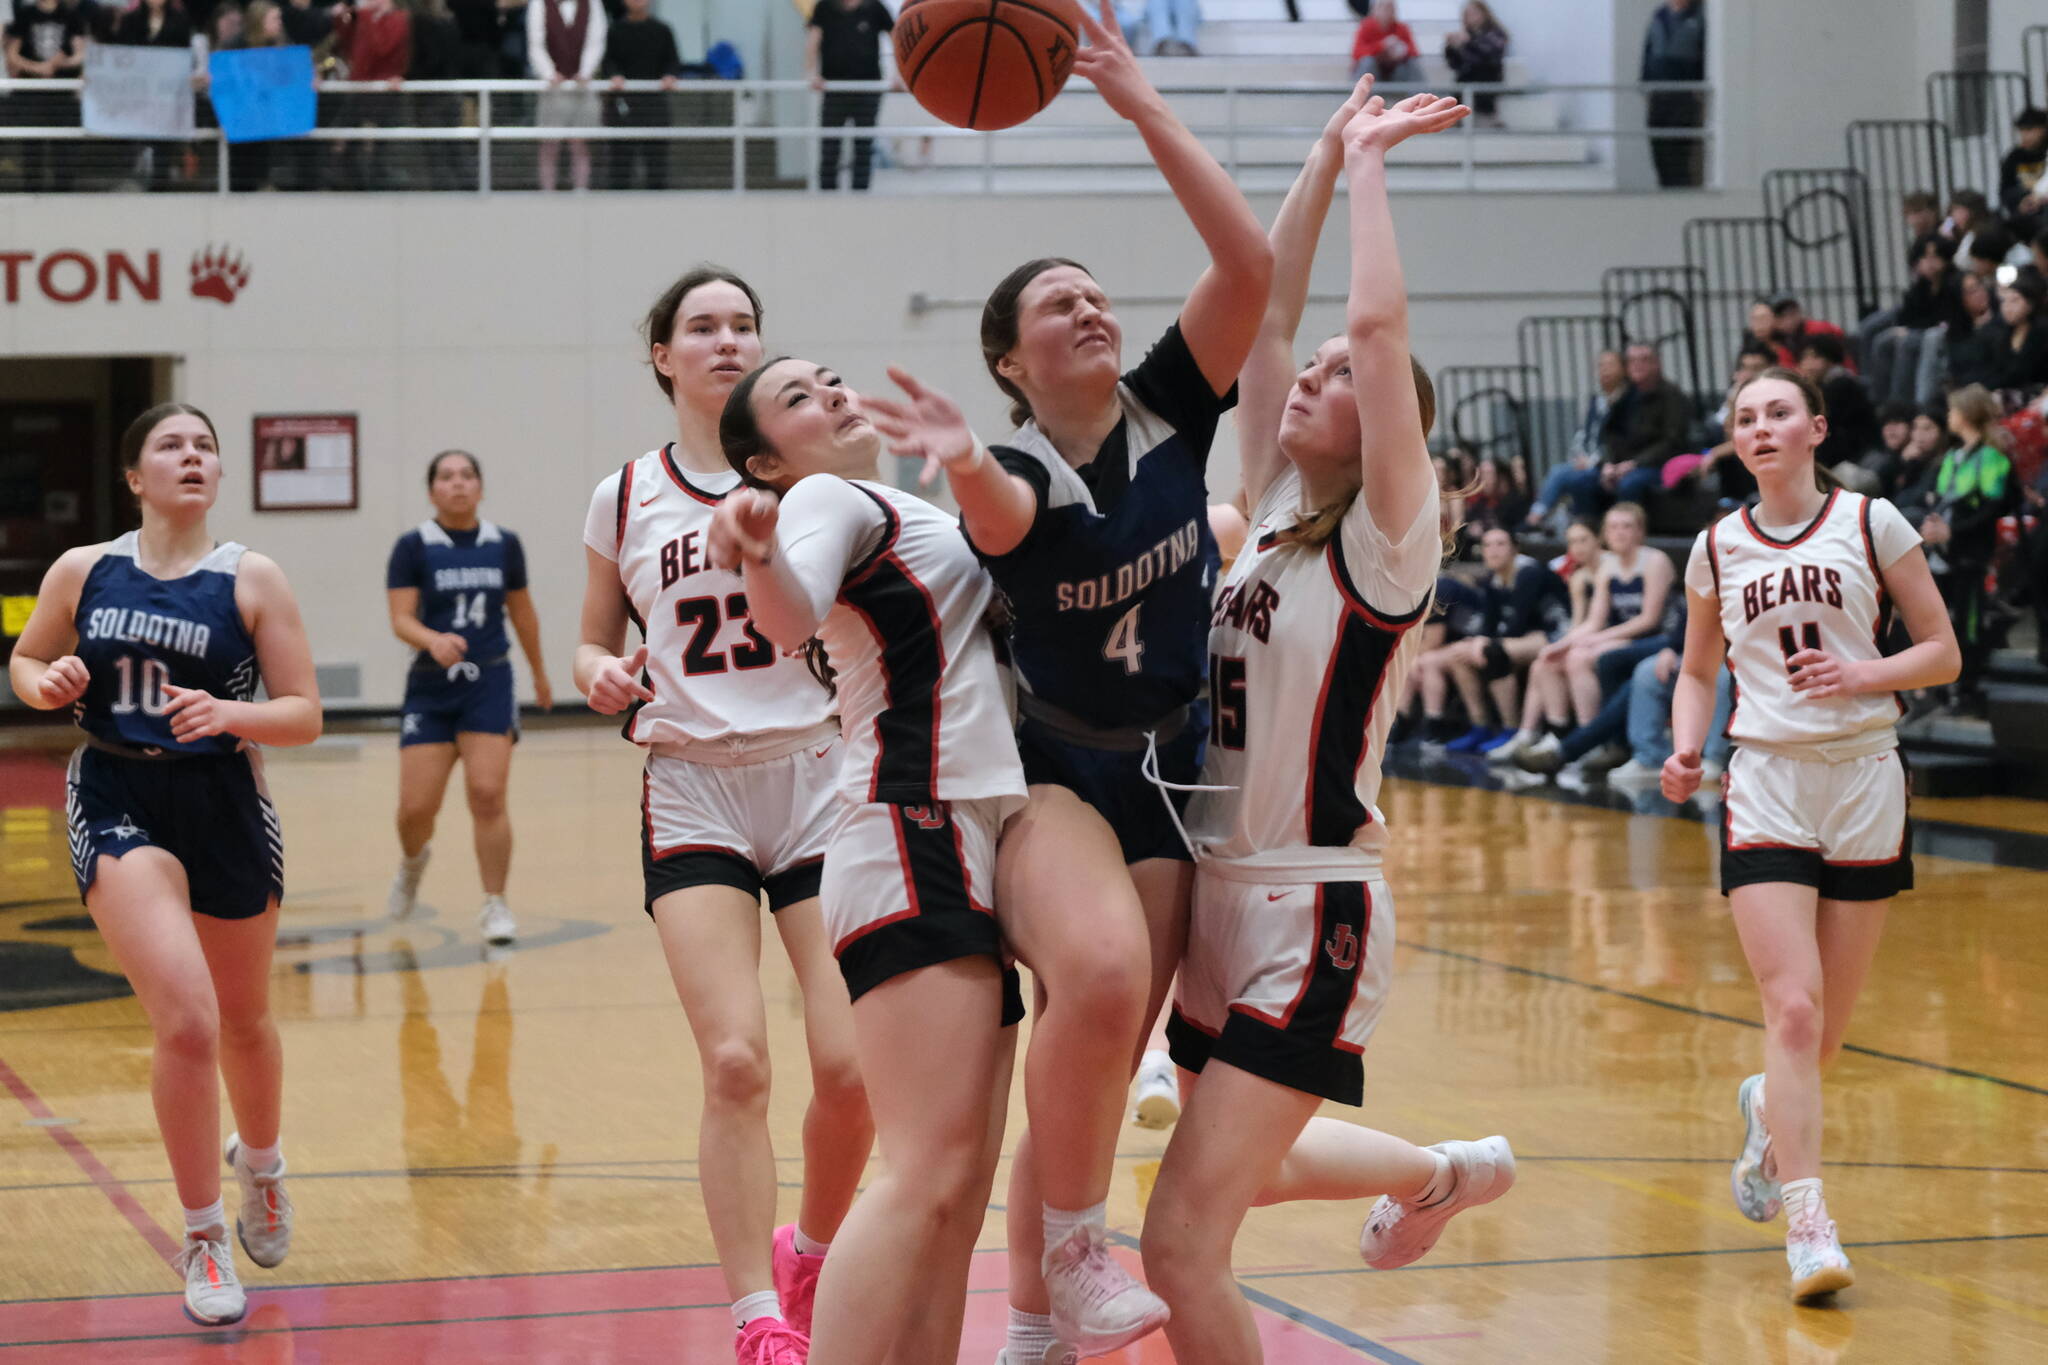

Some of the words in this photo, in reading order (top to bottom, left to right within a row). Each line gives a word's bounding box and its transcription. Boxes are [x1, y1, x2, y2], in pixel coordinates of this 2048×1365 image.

[0, 249, 160, 304] TON
[1056, 518, 1199, 613] SOLDOTNA
[1743, 564, 1843, 625] BEARS
[86, 606, 211, 660] SOLDOTNA
[450, 591, 487, 630] 14
[675, 592, 777, 678] 23
[1102, 600, 1145, 676] 4
[111, 656, 170, 717] 10
[1209, 652, 1247, 752] 15
